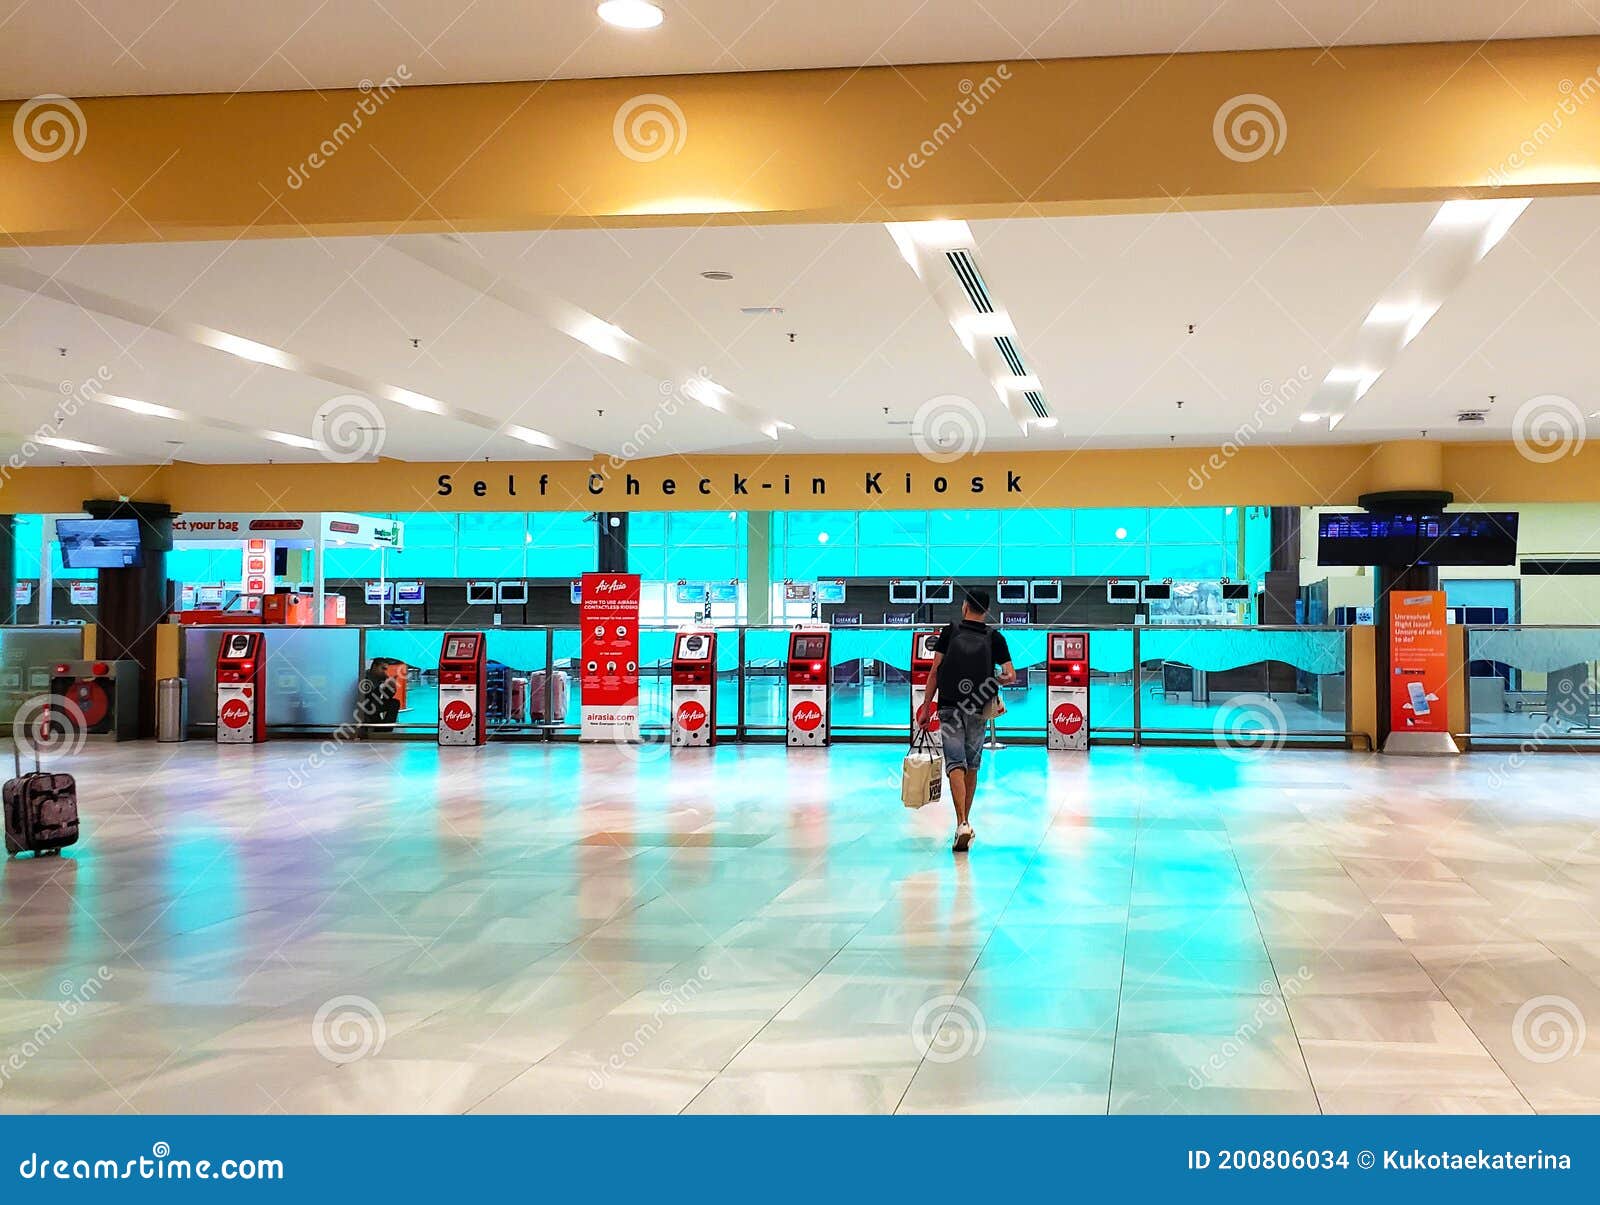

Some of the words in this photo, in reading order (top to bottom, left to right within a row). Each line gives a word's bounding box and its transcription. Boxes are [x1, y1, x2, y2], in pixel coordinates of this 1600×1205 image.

[437, 474, 549, 497] Self
[588, 473, 826, 496] Check-in
[865, 472, 1022, 495] Kiosk
[190, 522, 215, 531] your
[218, 519, 238, 531] bag
[1162, 577, 1173, 585] 29
[1219, 577, 1230, 585] 30
[587, 712, 635, 721] airasia.com
